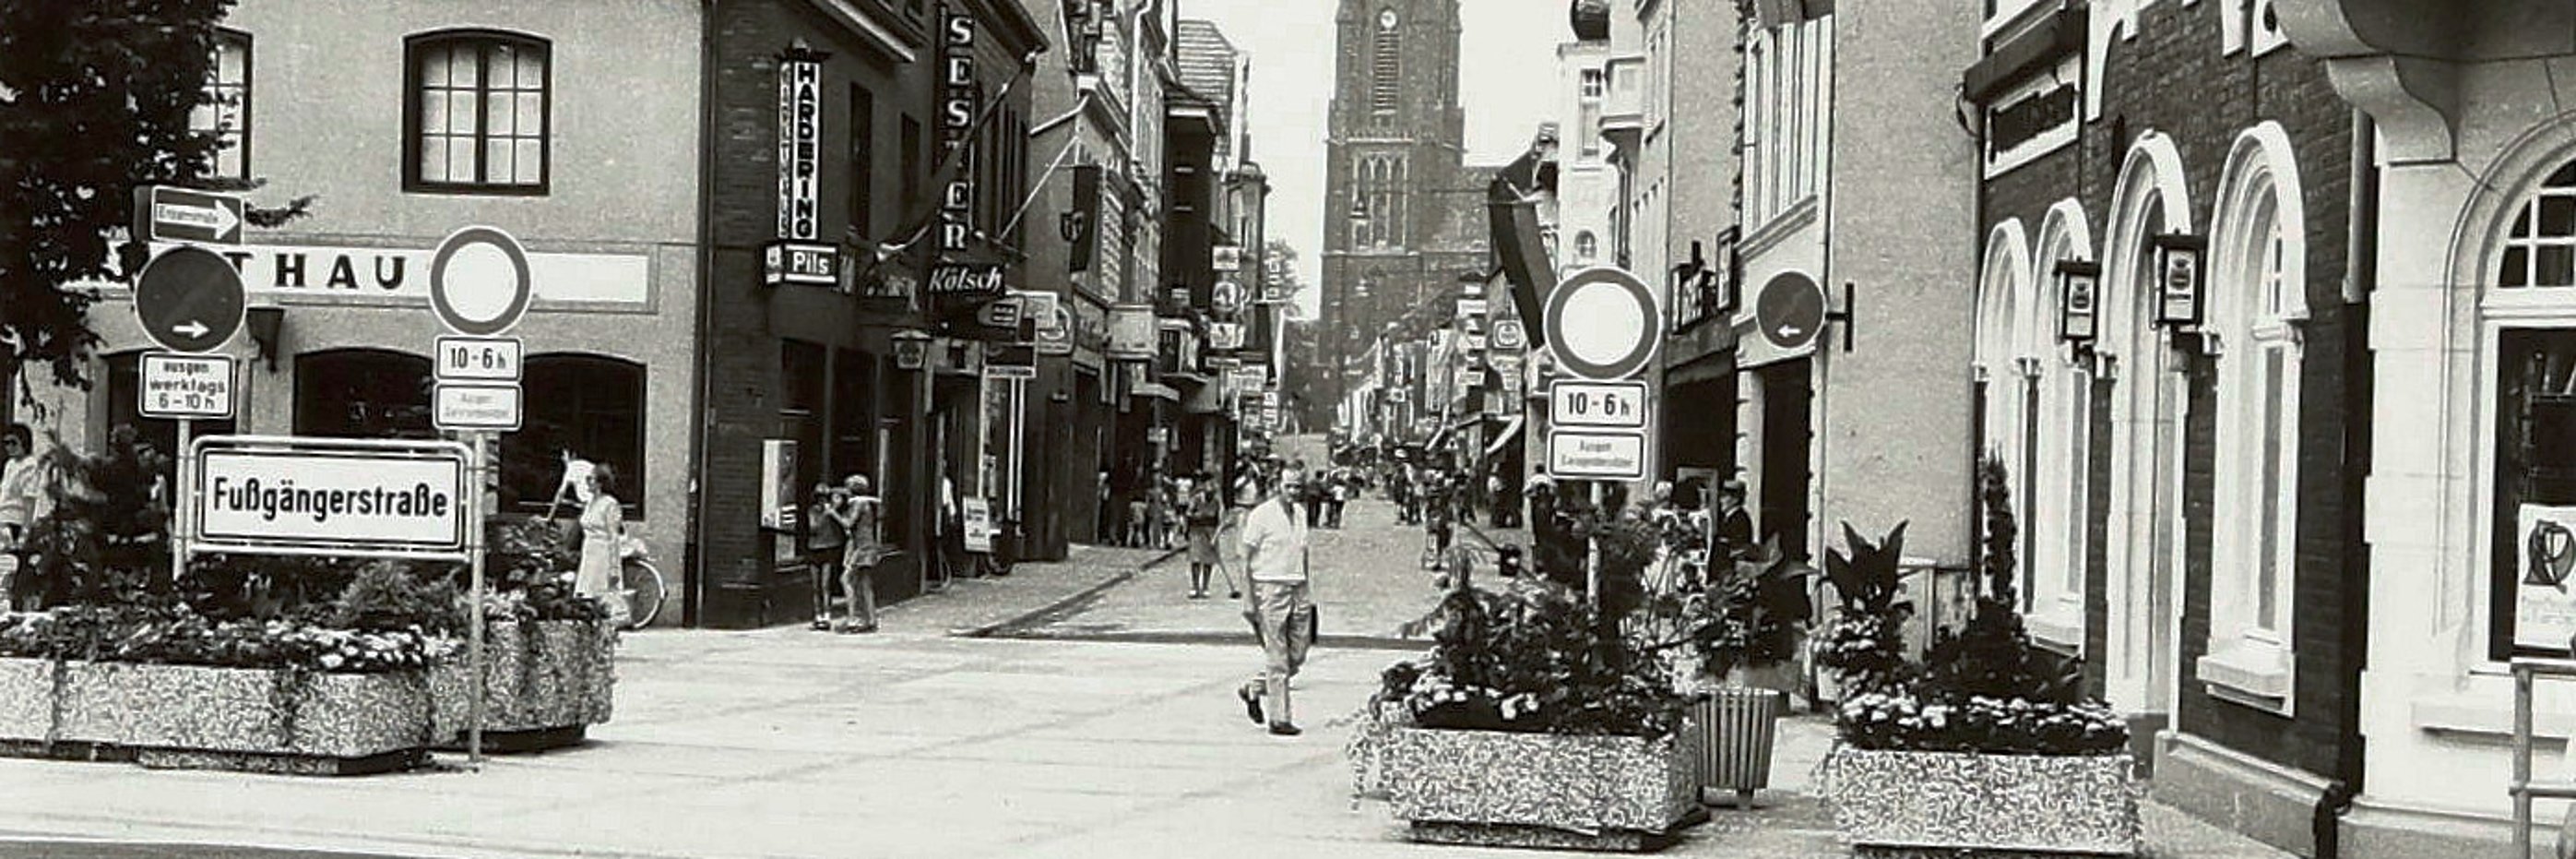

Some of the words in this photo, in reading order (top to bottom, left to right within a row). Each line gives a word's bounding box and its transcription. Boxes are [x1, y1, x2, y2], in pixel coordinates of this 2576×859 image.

[796, 64, 816, 238] HARDERING
[793, 251, 829, 274] Pils
[929, 267, 1002, 292] Kölsch
[149, 377, 226, 397] werktags
[214, 477, 448, 522] Fußgängerstraße
